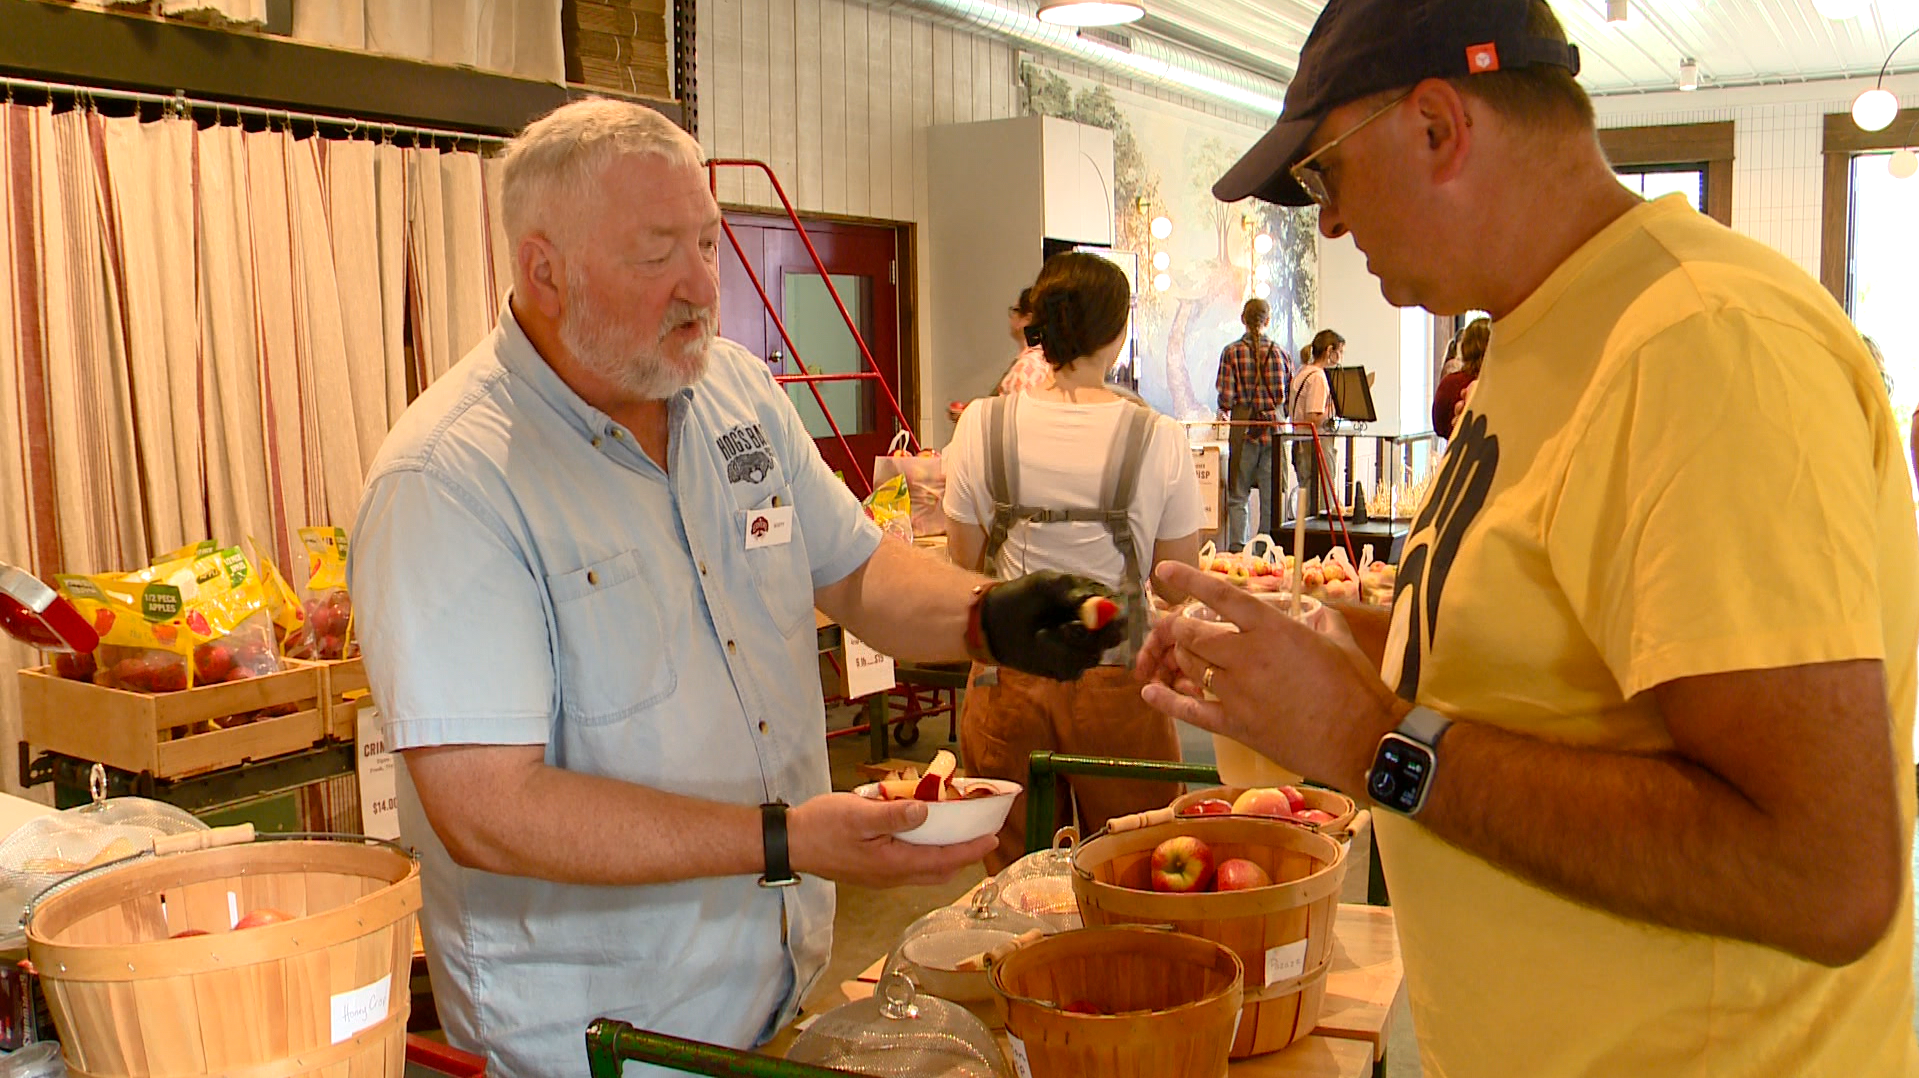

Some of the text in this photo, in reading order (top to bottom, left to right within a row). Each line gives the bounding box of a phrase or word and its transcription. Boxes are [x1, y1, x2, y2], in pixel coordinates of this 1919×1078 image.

[145, 594, 177, 603] 1/2 PECK
[149, 603, 176, 613] APPLES
